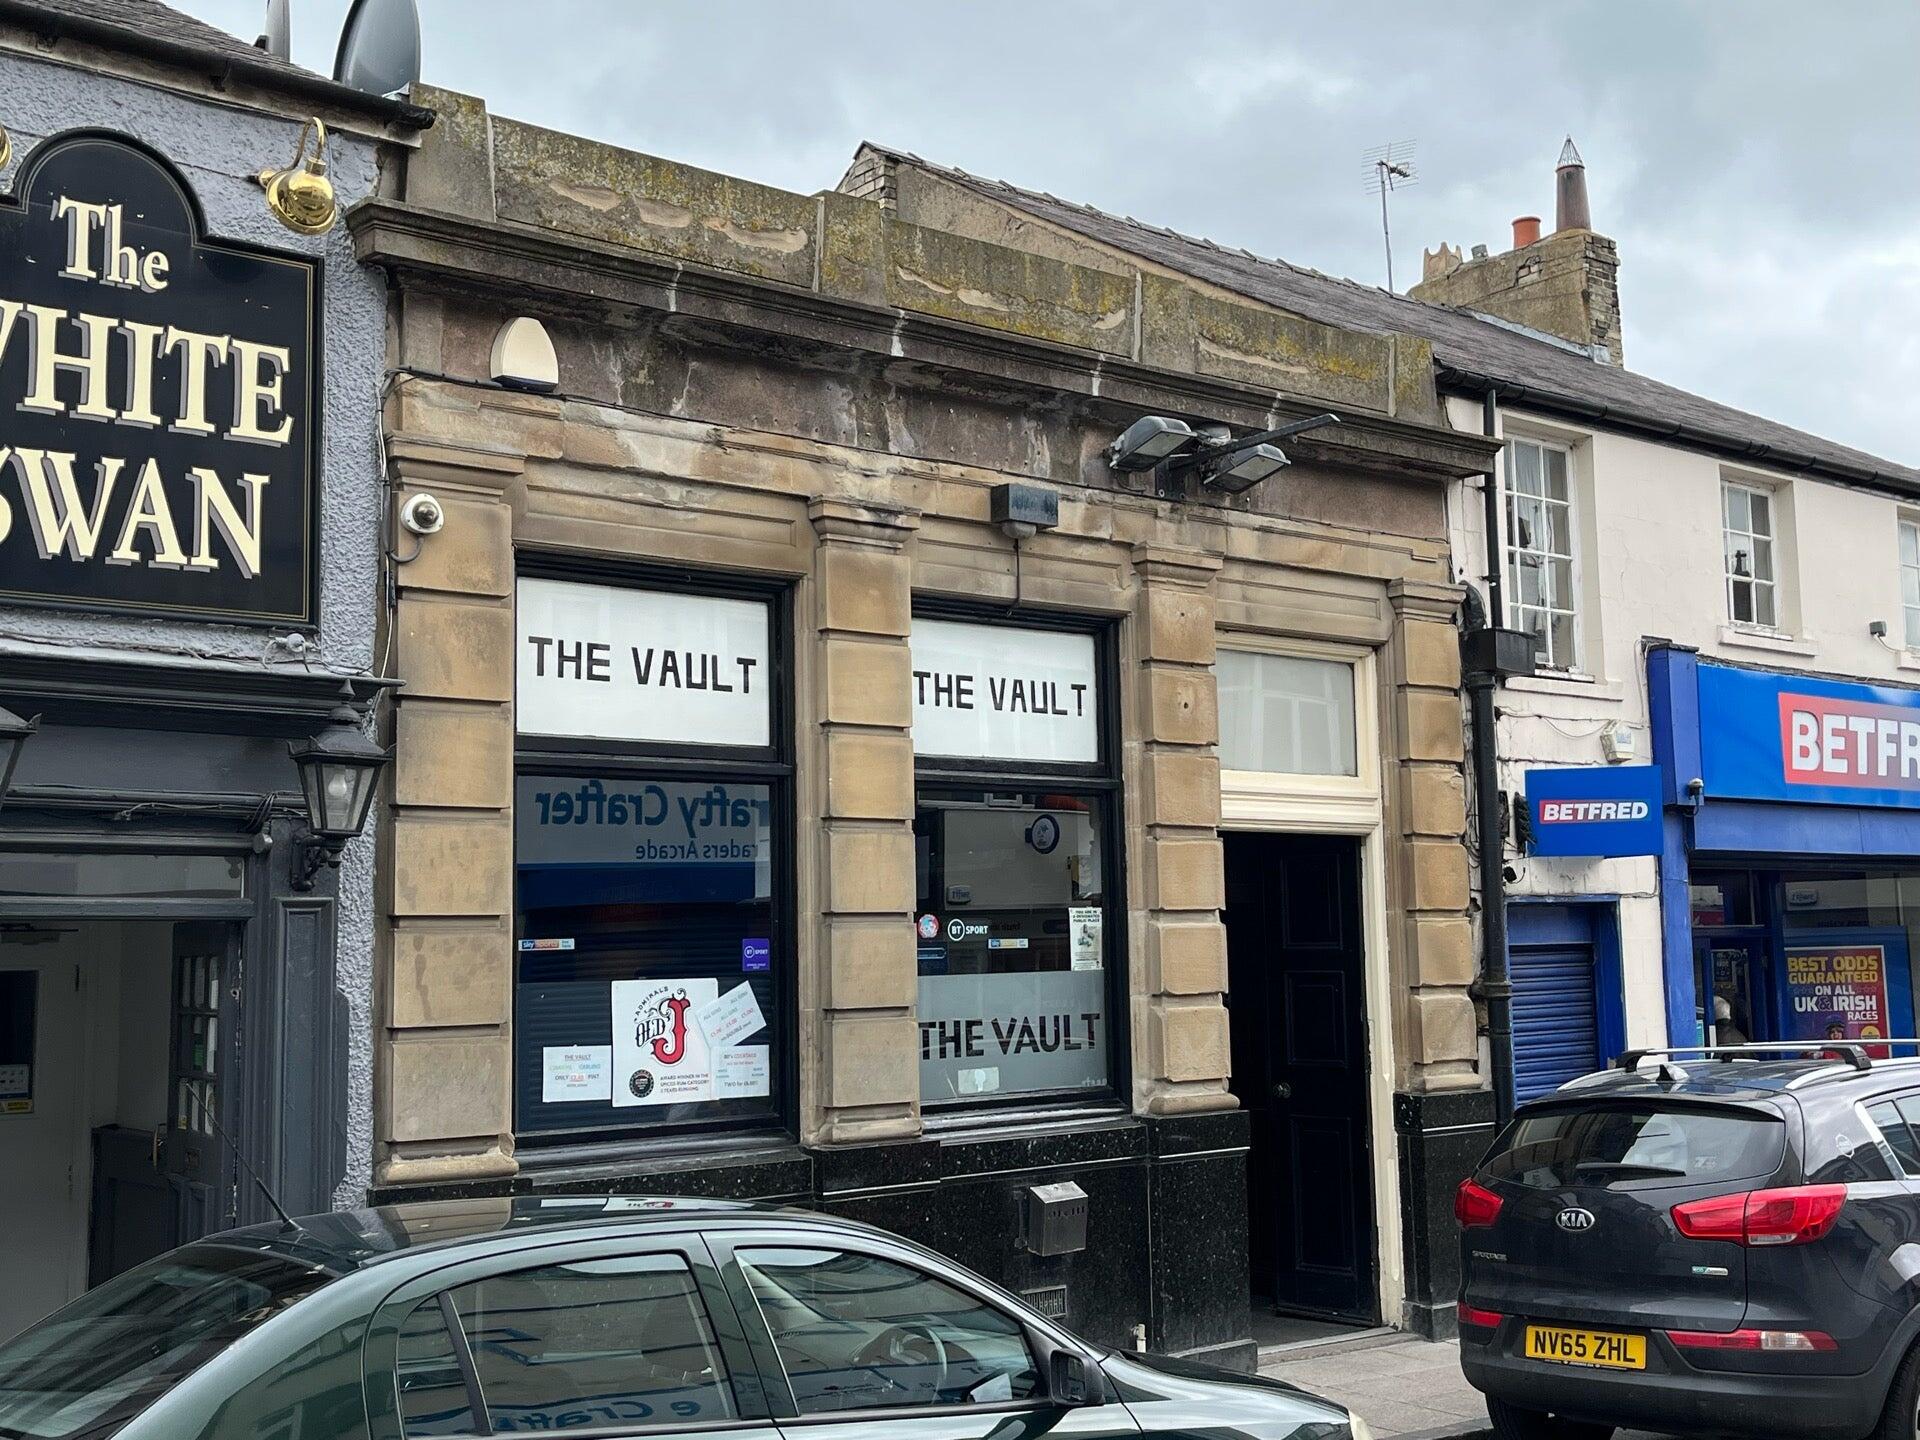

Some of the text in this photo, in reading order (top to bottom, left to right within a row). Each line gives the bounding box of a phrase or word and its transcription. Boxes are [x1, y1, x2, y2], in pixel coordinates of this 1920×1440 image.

[56, 195, 170, 292] The
[0, 300, 294, 445] HITE
[0, 445, 270, 577] WAN
[528, 636, 757, 694] THE VAULT
[913, 670, 1087, 717] THE VAULT
[1791, 709, 1920, 779] BETFR
[1543, 800, 1648, 821] BETFRED
[951, 925, 961, 934] BT
[966, 925, 989, 935] SPORT
[1787, 955, 1878, 972] BEST ODDS
[1788, 971, 1878, 985] GUARANTEED
[1815, 985, 1855, 995] ON ALL
[1847, 1011, 1878, 1021] RACES
[918, 1013, 1100, 1060] THE VAULT
[1561, 1212, 1587, 1227] KIA
[1534, 1330, 1636, 1363] NV65 ZHL
